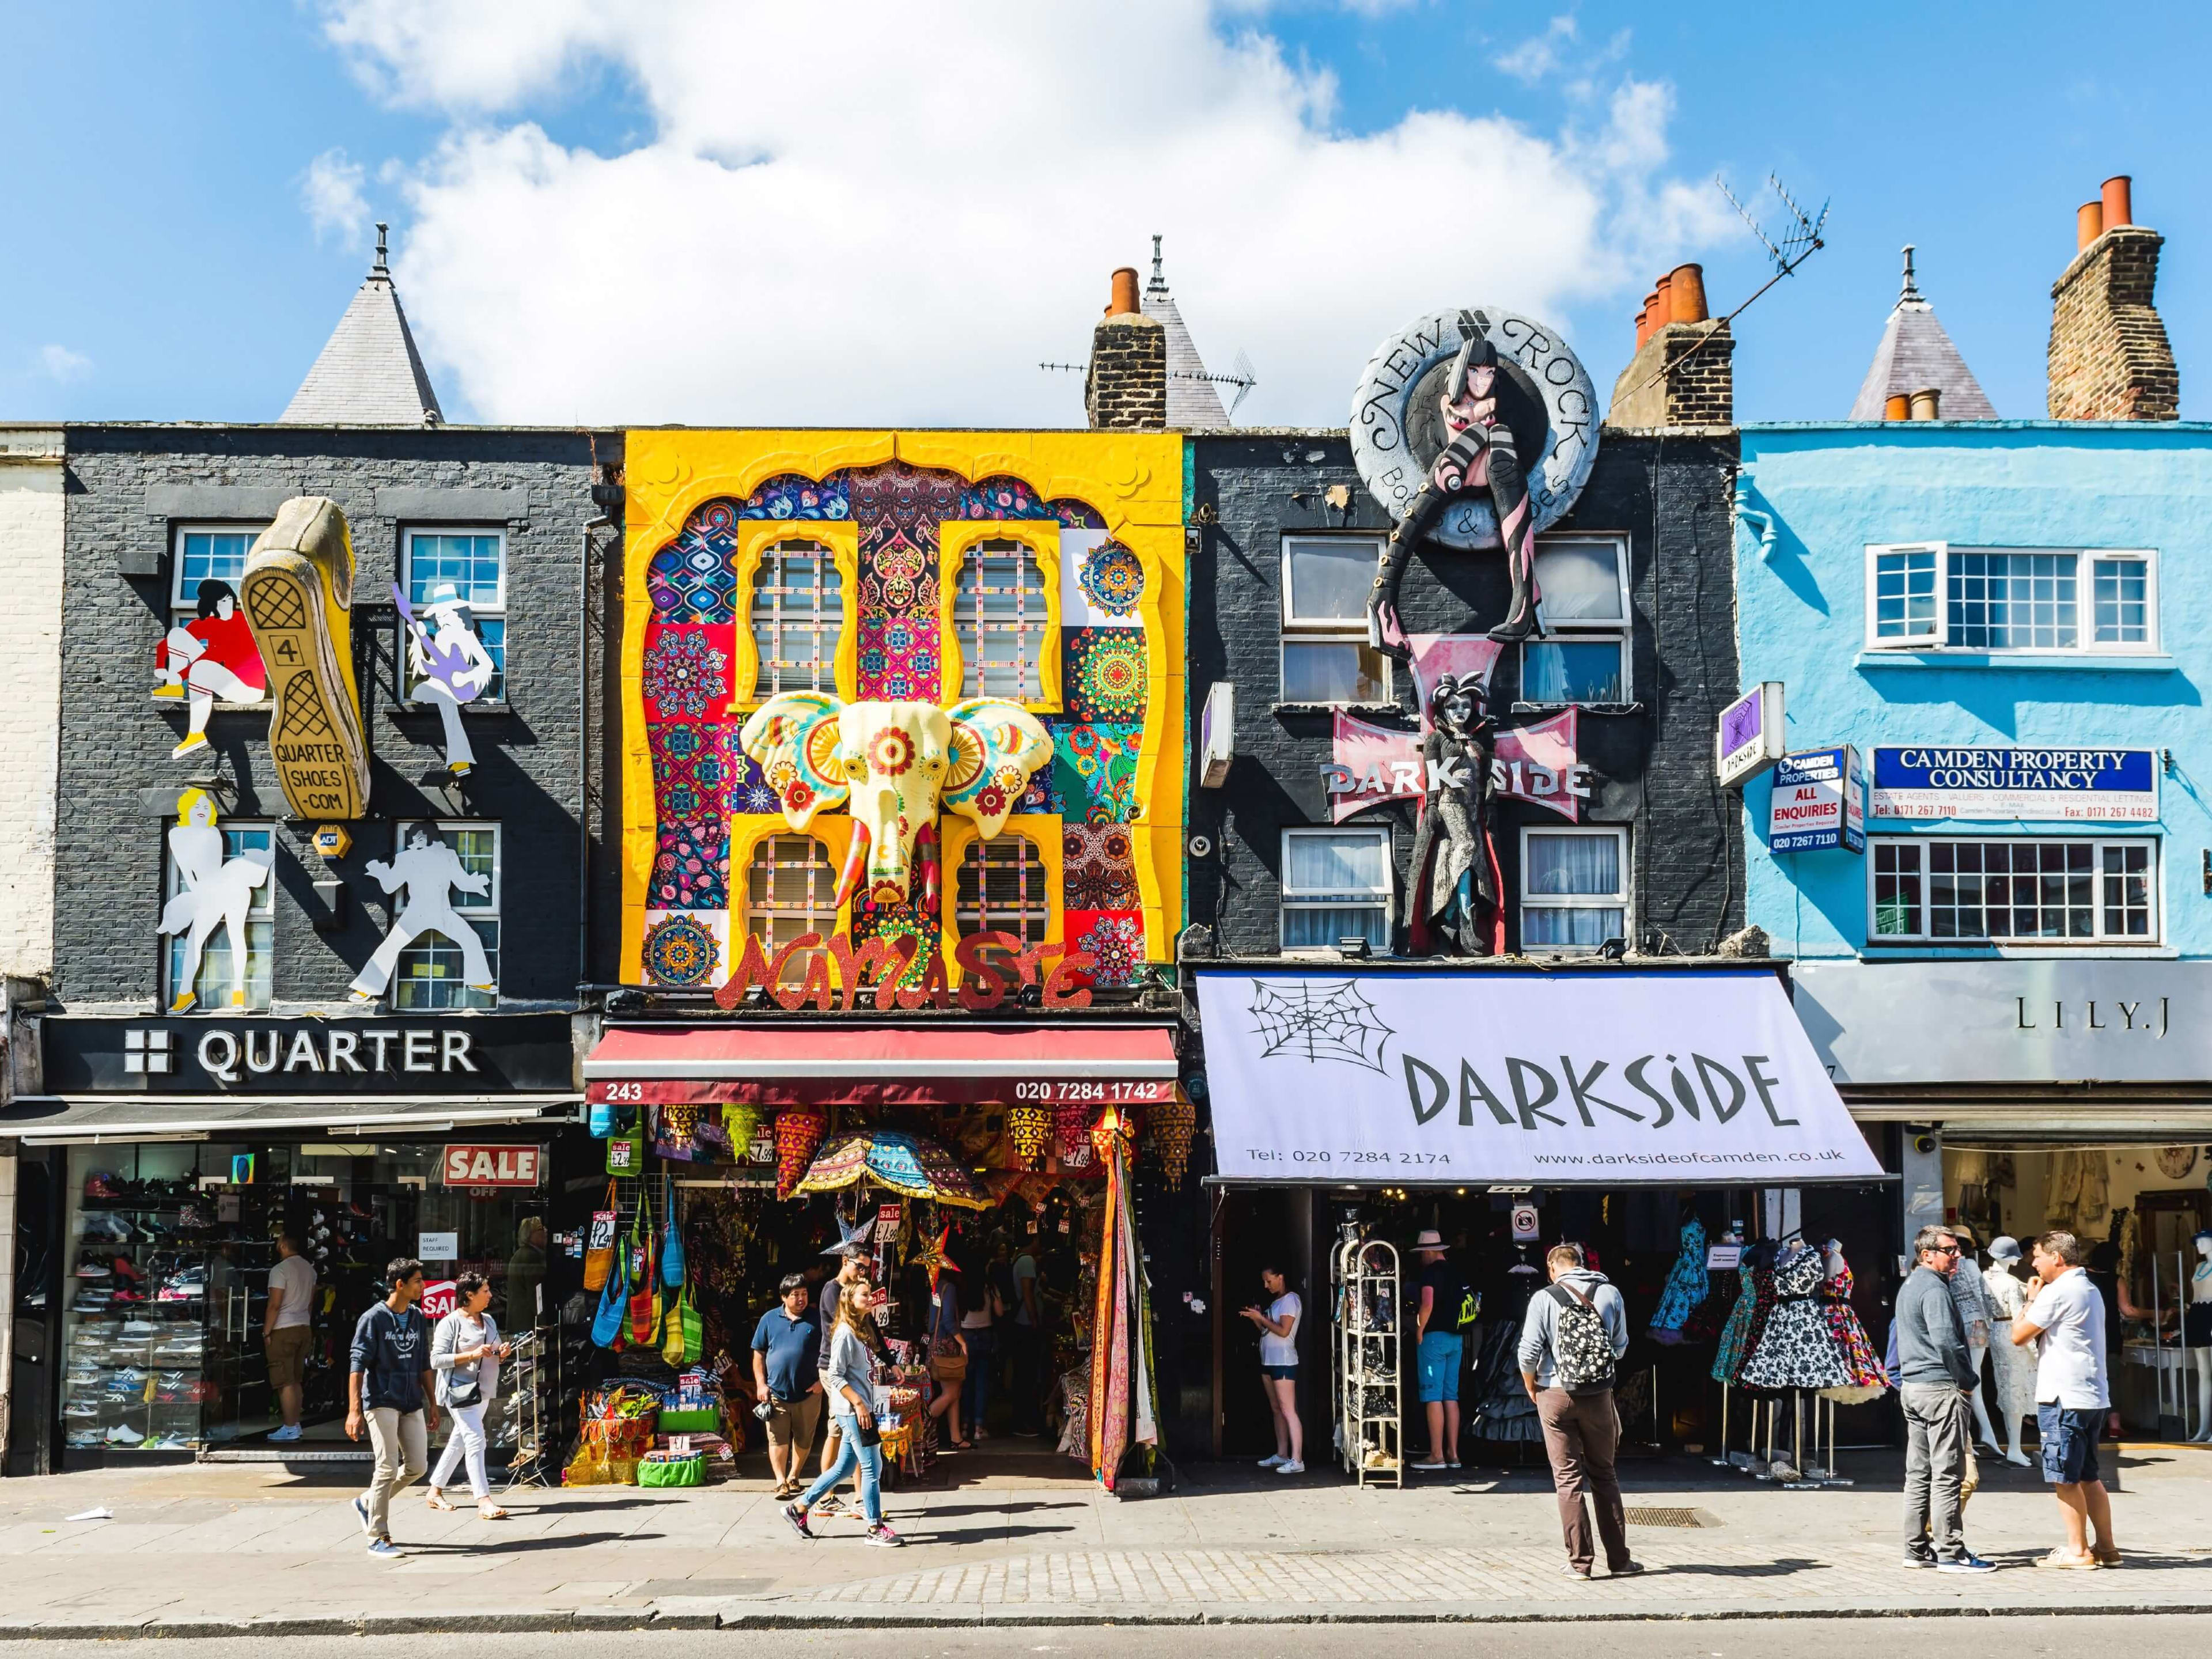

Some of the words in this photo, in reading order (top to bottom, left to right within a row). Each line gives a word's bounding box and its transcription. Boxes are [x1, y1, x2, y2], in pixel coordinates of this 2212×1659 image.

[1361, 318, 1442, 451] NEW
[1502, 319, 1590, 460] ROCK
[276, 638, 298, 663] 4
[276, 744, 345, 765] QUARTER
[1727, 743, 1757, 773] DARKSIDE
[1793, 755, 1835, 770] CAMDEN
[1900, 749, 2004, 768] CAMDEN
[2009, 751, 2127, 770] PROPERTY
[292, 770, 343, 788] SHOES
[1779, 767, 1839, 785] PROPERTIES
[1929, 769, 2099, 789] CONSULTANCY
[1794, 787, 1817, 801] ALL
[1874, 792, 1903, 801] ESTATE
[1906, 793, 1940, 801] AGENTS
[1948, 793, 1984, 801] VALUERS
[1993, 793, 2047, 802] COMMERCIAL
[2058, 794, 2111, 802] RESIDENTIAL
[2114, 795, 2153, 803] LETTINGS
[1774, 802, 1838, 821] ENQUIRIES
[1874, 805, 1891, 815] Tel:
[1895, 805, 1913, 815] 0171
[1918, 805, 1934, 815] 267
[1939, 805, 1956, 816] 7110
[2065, 806, 2084, 817] Fax:
[2087, 807, 2106, 817] 0171
[2111, 807, 2126, 817] 267
[2130, 808, 2153, 817] 4482
[1773, 838, 1790, 849] 020
[1792, 836, 1813, 847] 7267
[1816, 833, 1837, 844] 7110
[197, 1028, 481, 1082] QUARTER
[606, 1083, 642, 1101] 243
[1016, 1082, 1051, 1100] 020
[1056, 1082, 1104, 1100] 7284
[1111, 1082, 1158, 1100] 1742
[449, 1150, 535, 1180] SALE
[1247, 1149, 1282, 1161] Tel:
[1293, 1150, 1331, 1161] 020
[1339, 1152, 1391, 1162] 7284
[1400, 1153, 1451, 1164] 2174
[1533, 1149, 1844, 1164] www.darksideofcamden.co.uk
[469, 1187, 497, 1197] OFF
[879, 1207, 900, 1219] sale
[423, 1296, 456, 1315] SAL
[872, 1292, 886, 1304] ale
[680, 1376, 699, 1385] sale
[674, 1437, 684, 1450] £1
